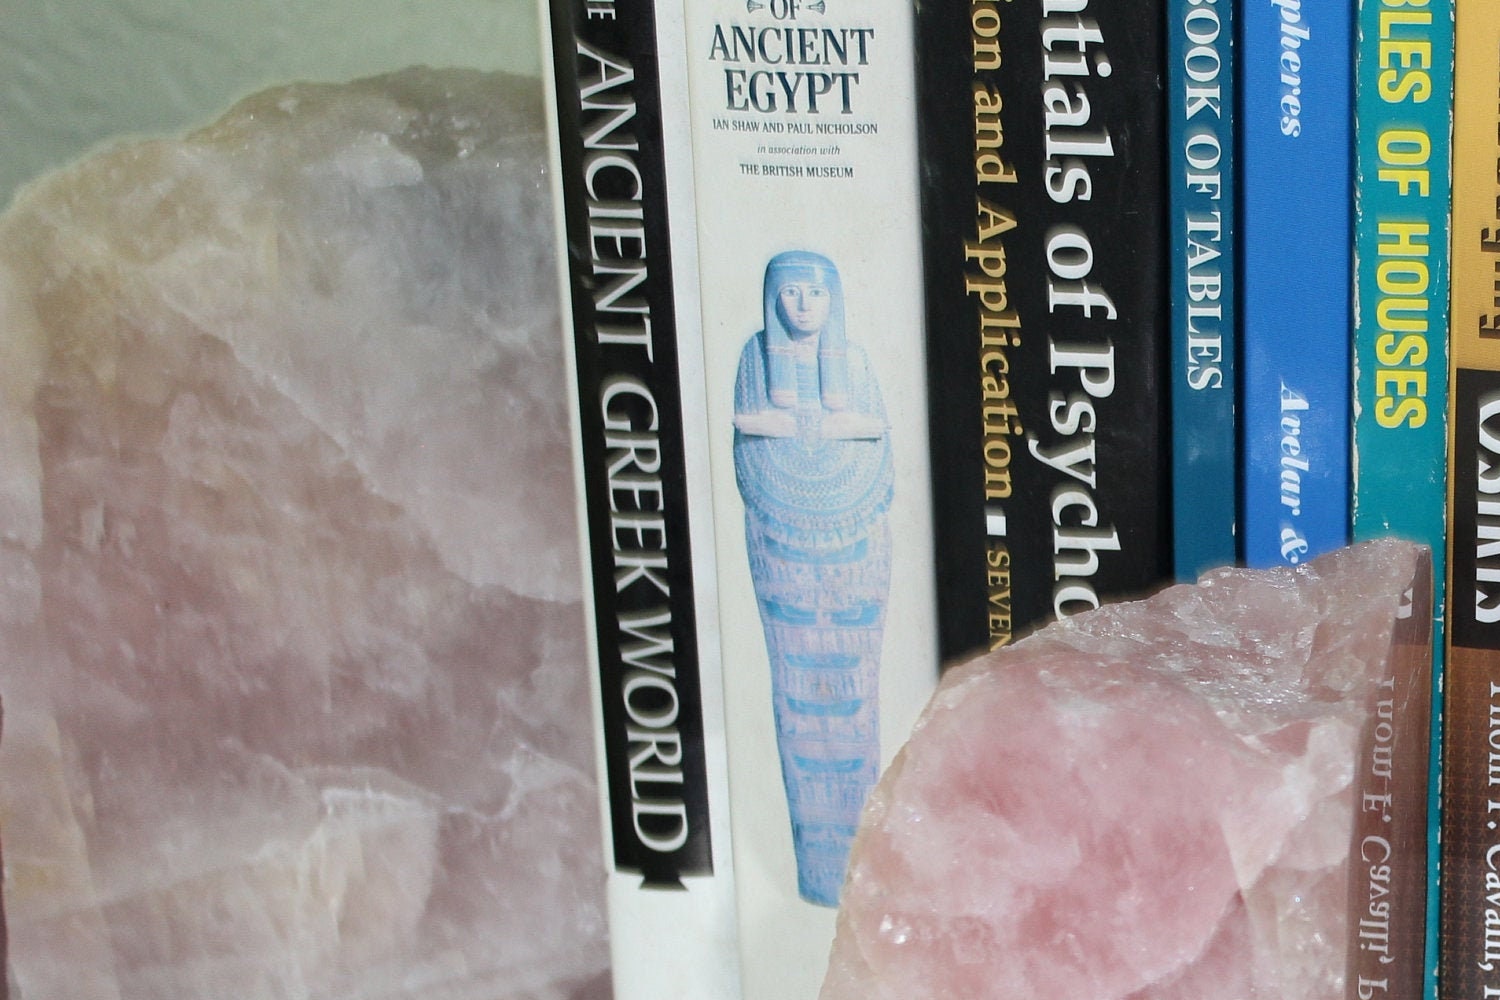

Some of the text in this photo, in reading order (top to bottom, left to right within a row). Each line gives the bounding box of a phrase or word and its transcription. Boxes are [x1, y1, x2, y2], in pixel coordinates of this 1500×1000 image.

[708, 24, 875, 66] ANCIENT
[972, 0, 1011, 73] on
[712, 118, 878, 135] IAN SHAW AND PAUL NICHOLSON
[724, 68, 859, 114] EGYPT
[973, 90, 1018, 185] and
[740, 163, 854, 179] THE BRITISH MUSEUM
[757, 144, 841, 156] in association with
[1185, 0, 1223, 390] OOK OF TABLES
[577, 42, 654, 363] ANCIENT
[1375, 0, 1432, 428] LES OF HOUSES
[1046, 233, 1117, 320] of
[965, 203, 1024, 500] Application
[601, 381, 671, 598] GREEK
[1280, 382, 1310, 564] Avelar &
[617, 611, 689, 852] WORLD
